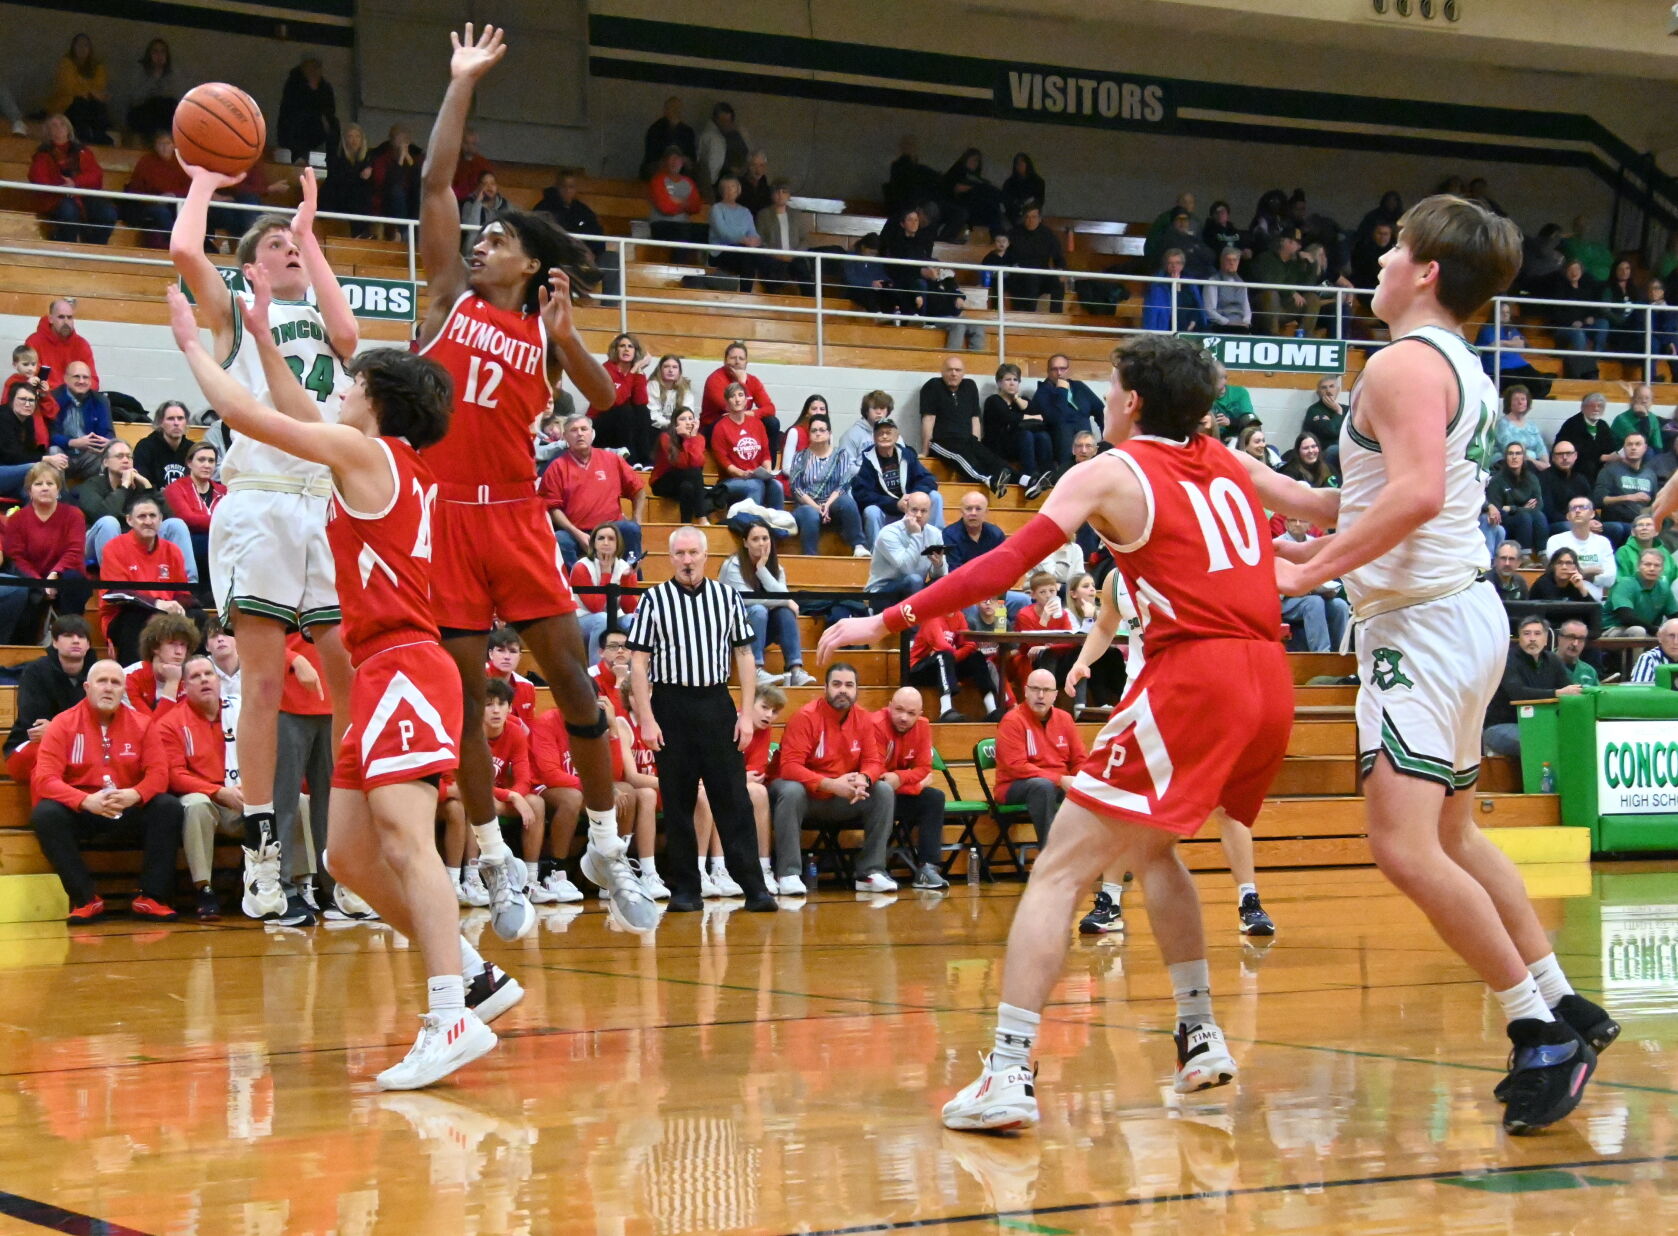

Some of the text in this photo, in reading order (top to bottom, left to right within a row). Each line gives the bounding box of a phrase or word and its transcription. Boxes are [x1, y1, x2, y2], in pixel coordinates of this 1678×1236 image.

[1008, 71, 1165, 122] VISITORS
[270, 319, 332, 347] ONCO
[447, 312, 542, 375] PLYMOUTH
[1224, 341, 1340, 367] HOME
[462, 355, 504, 408] 12
[1177, 476, 1261, 573] 10
[398, 719, 415, 752] P
[1102, 743, 1127, 779] P
[1604, 741, 1678, 789] CONCO
[1620, 793, 1678, 808] HIGH SCH
[1192, 1031, 1219, 1043] TIME
[1008, 1073, 1034, 1084] DAM
